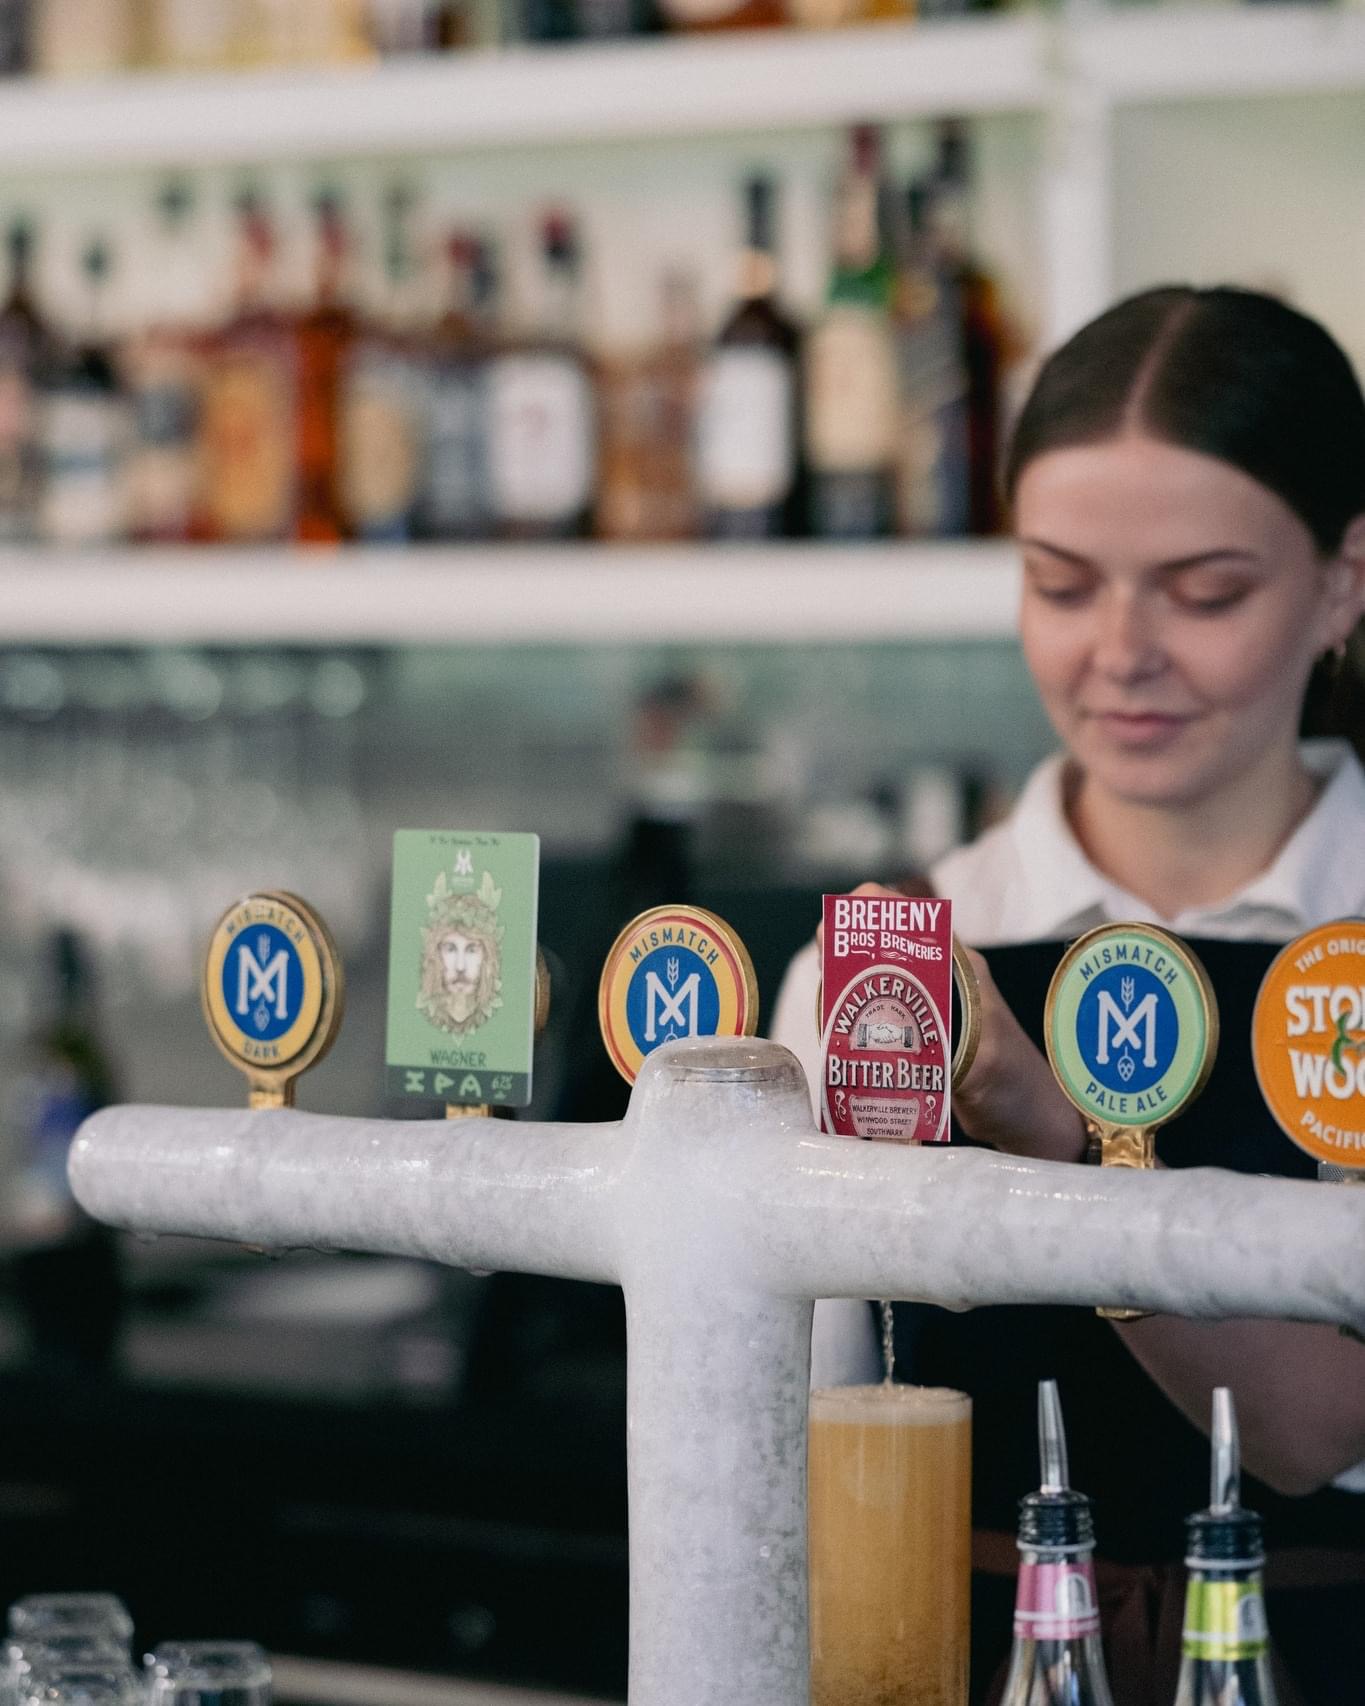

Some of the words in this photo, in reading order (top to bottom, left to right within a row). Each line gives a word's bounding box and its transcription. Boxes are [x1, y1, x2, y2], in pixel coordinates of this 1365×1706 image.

[834, 898, 942, 933] BREHENY
[629, 927, 720, 966] MISMATCH
[833, 930, 876, 957] BROS
[879, 930, 944, 962] BREWERIES
[1295, 943, 1325, 974] THE
[1078, 943, 1179, 986] MISMATCH
[834, 976, 940, 1048] WALKERVILLE
[865, 1003, 885, 1019] TRADE
[890, 1005, 907, 1020] MARK
[1285, 984, 1365, 1038] STO
[243, 1040, 280, 1058] DARK
[429, 1049, 488, 1068] WAGNER
[405, 1069, 482, 1099] IPA
[828, 1053, 894, 1089] BITTER
[896, 1057, 945, 1092] BEER
[852, 1104, 888, 1115] WALKERVILLE
[889, 1106, 918, 1116] BREWERY
[1084, 1081, 1128, 1114] PALE
[1135, 1085, 1169, 1113] ALE
[866, 1127, 905, 1138] SOUTHWARK
[889, 1117, 913, 1126] STREET
